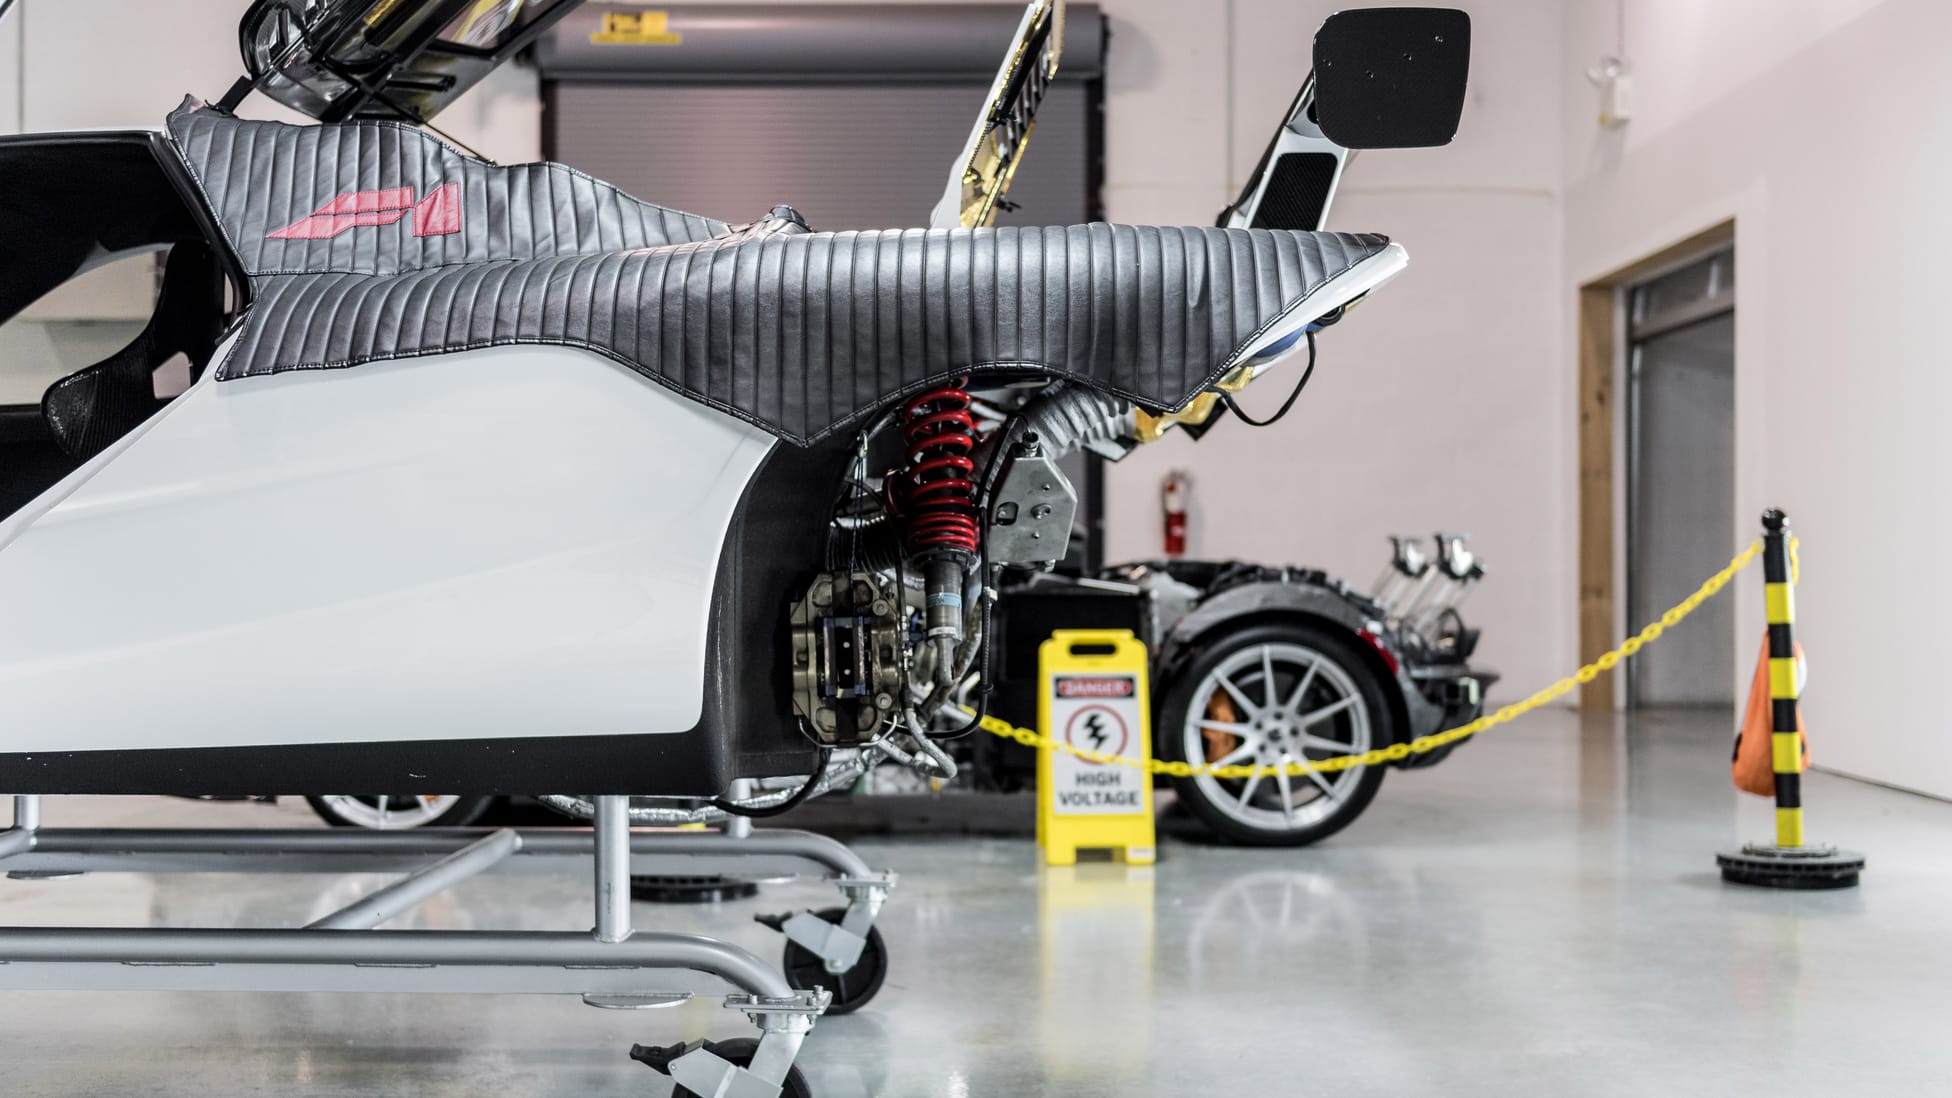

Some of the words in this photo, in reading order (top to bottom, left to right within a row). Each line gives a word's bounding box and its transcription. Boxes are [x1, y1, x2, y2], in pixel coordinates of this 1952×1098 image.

[1064, 681, 1125, 695] DANGER
[1075, 772, 1121, 786] HIGH
[1058, 791, 1139, 806] VOLTAGE
